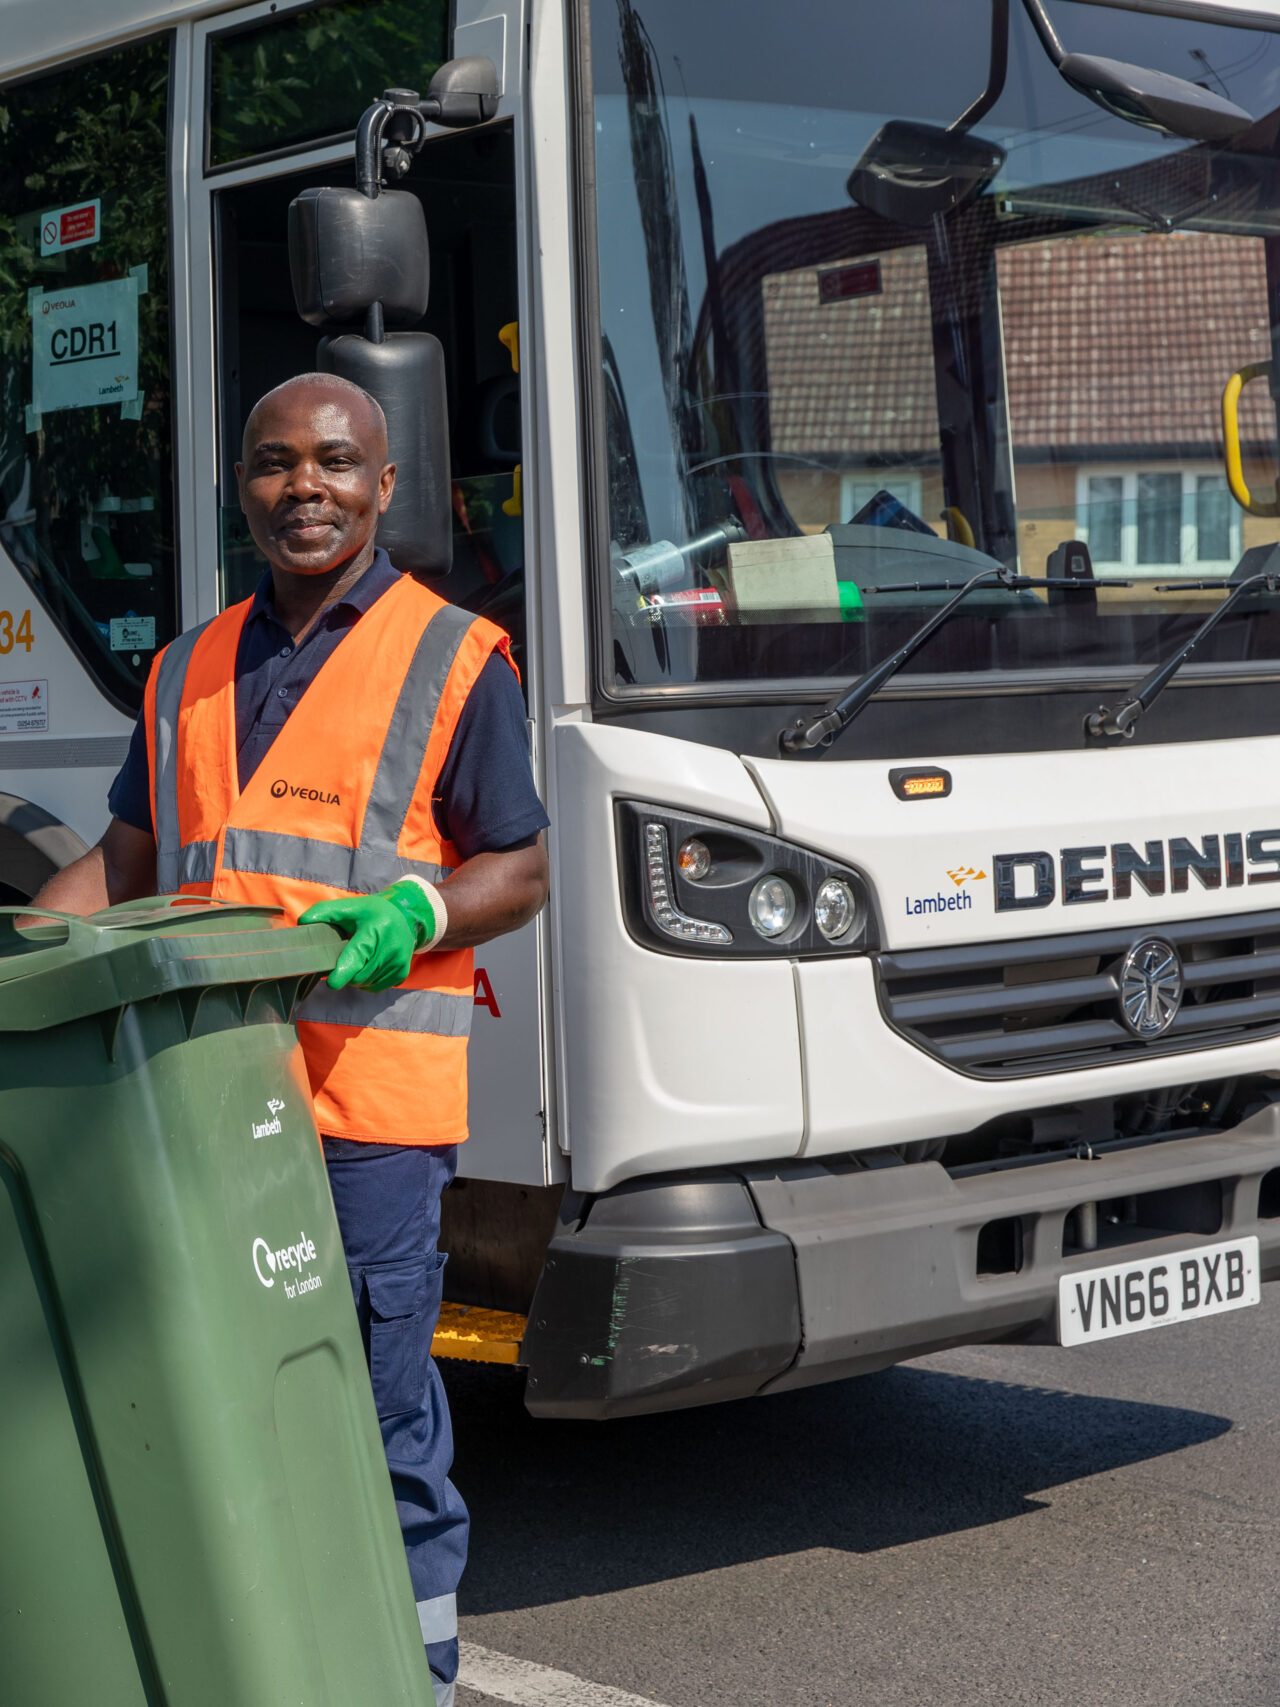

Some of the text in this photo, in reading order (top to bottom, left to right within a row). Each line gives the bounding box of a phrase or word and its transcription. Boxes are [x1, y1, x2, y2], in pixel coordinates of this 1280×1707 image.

[51, 300, 76, 310] VEOLIA
[50, 320, 117, 360] CDR1
[98, 384, 124, 395] Lambeth
[15, 695, 28, 703] CCTV
[290, 786, 340, 806] VEOLIA
[992, 829, 1280, 913] DENNIS
[905, 890, 972, 915] Lambeth
[252, 1116, 282, 1139] Lambeth
[275, 1231, 317, 1272] recycle
[284, 1272, 322, 1299] for London
[1075, 1249, 1244, 1332] VN66 BXB
